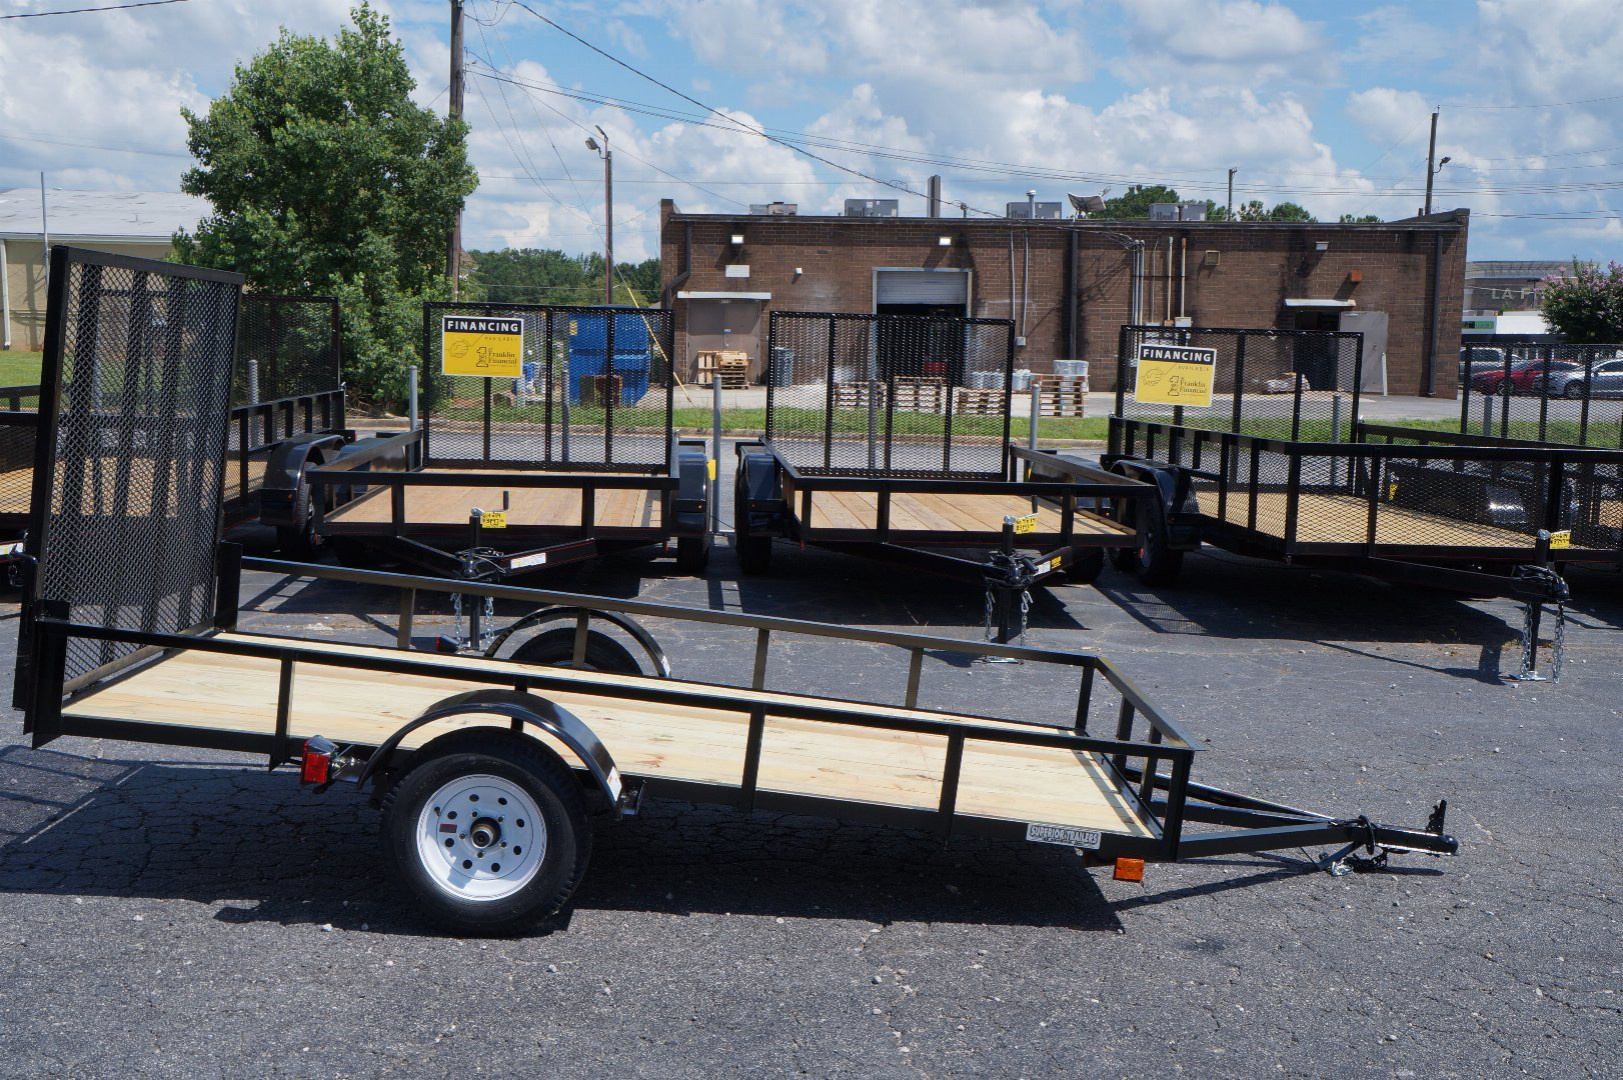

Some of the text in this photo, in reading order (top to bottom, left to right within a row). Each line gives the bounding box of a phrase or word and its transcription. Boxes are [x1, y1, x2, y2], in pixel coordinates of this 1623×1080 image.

[1491, 288, 1513, 300] LA
[447, 320, 518, 332] FINANCING
[488, 350, 515, 358] Franklin
[1143, 348, 1211, 362] FINANCING
[1180, 379, 1206, 388] Franklin
[1031, 825, 1065, 840] SUPERIOR
[1066, 830, 1099, 845] TRAILERS
